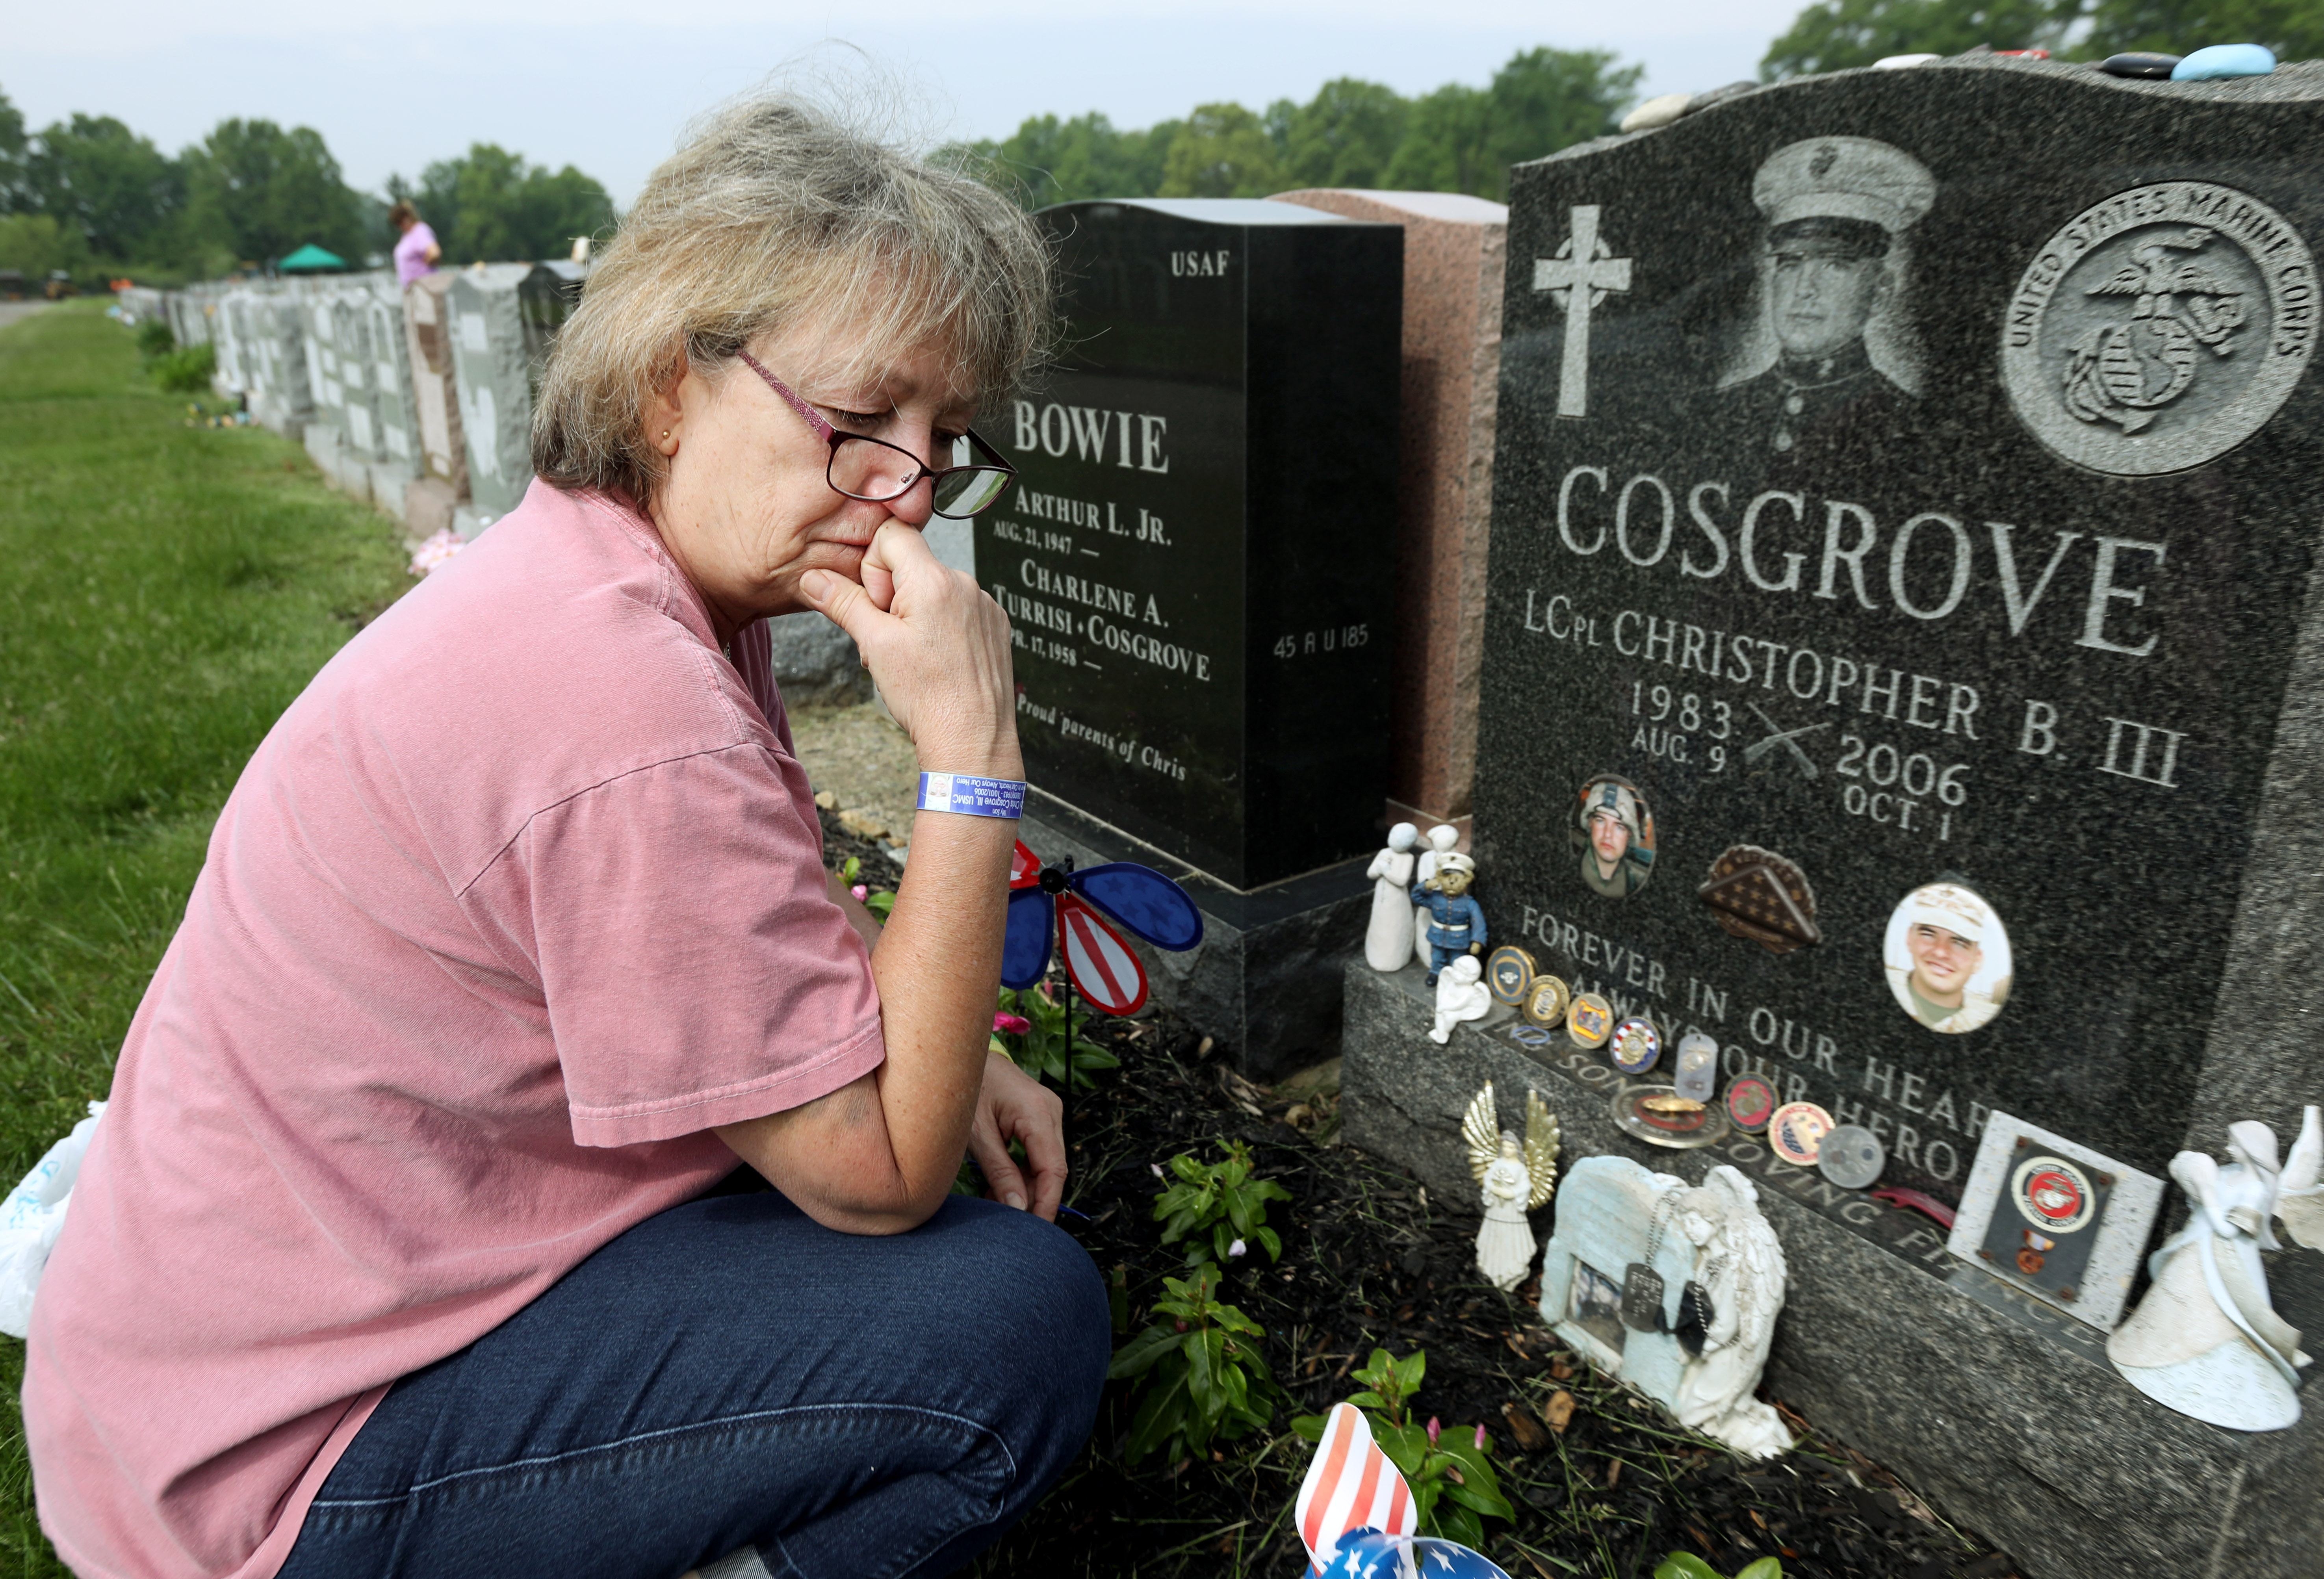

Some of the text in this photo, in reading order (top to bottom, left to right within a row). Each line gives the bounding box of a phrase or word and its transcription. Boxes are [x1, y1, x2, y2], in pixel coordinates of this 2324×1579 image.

[1171, 250, 1231, 277] USAF
[2010, 191, 2311, 357] UNITED STATES MARINE CORPS
[1014, 399, 1169, 474] BOWIE
[993, 519, 1023, 542] AUG.
[1025, 527, 1042, 550] 21,
[1044, 532, 1072, 555] 1947
[1014, 484, 1172, 547] ARTHUR L. JR.
[1557, 465, 2168, 657] COSGROVE
[1021, 558, 1169, 629] CHARLENE A.
[992, 583, 1210, 681] TURRISI COSGROVE
[1010, 627, 1028, 649] PR.
[1031, 635, 1046, 659] 17,
[1049, 642, 1077, 667] 1958
[1273, 623, 1368, 658] 45 A U 185
[1614, 610, 1980, 740] CHRISTOPHER
[2016, 699, 2069, 761] B.
[2096, 717, 2190, 788] III
[1017, 692, 1186, 781] Proud parents of Chris
[1632, 680, 1971, 806] 1983 2006
[952, 794, 974, 805] USMC
[956, 777, 970, 786] Hero
[970, 779, 981, 787] Our
[974, 788, 1000, 798] 10/01/2006
[982, 779, 998, 789] Always
[984, 797, 1010, 809] Cosgrove
[1010, 800, 1020, 809] Chris
[1631, 722, 1951, 841] AUG. 9 OCT. 1
[1521, 905, 1990, 1138] FOREVER IN OUR HEAR
[1712, 1142, 1884, 1225] OVING
